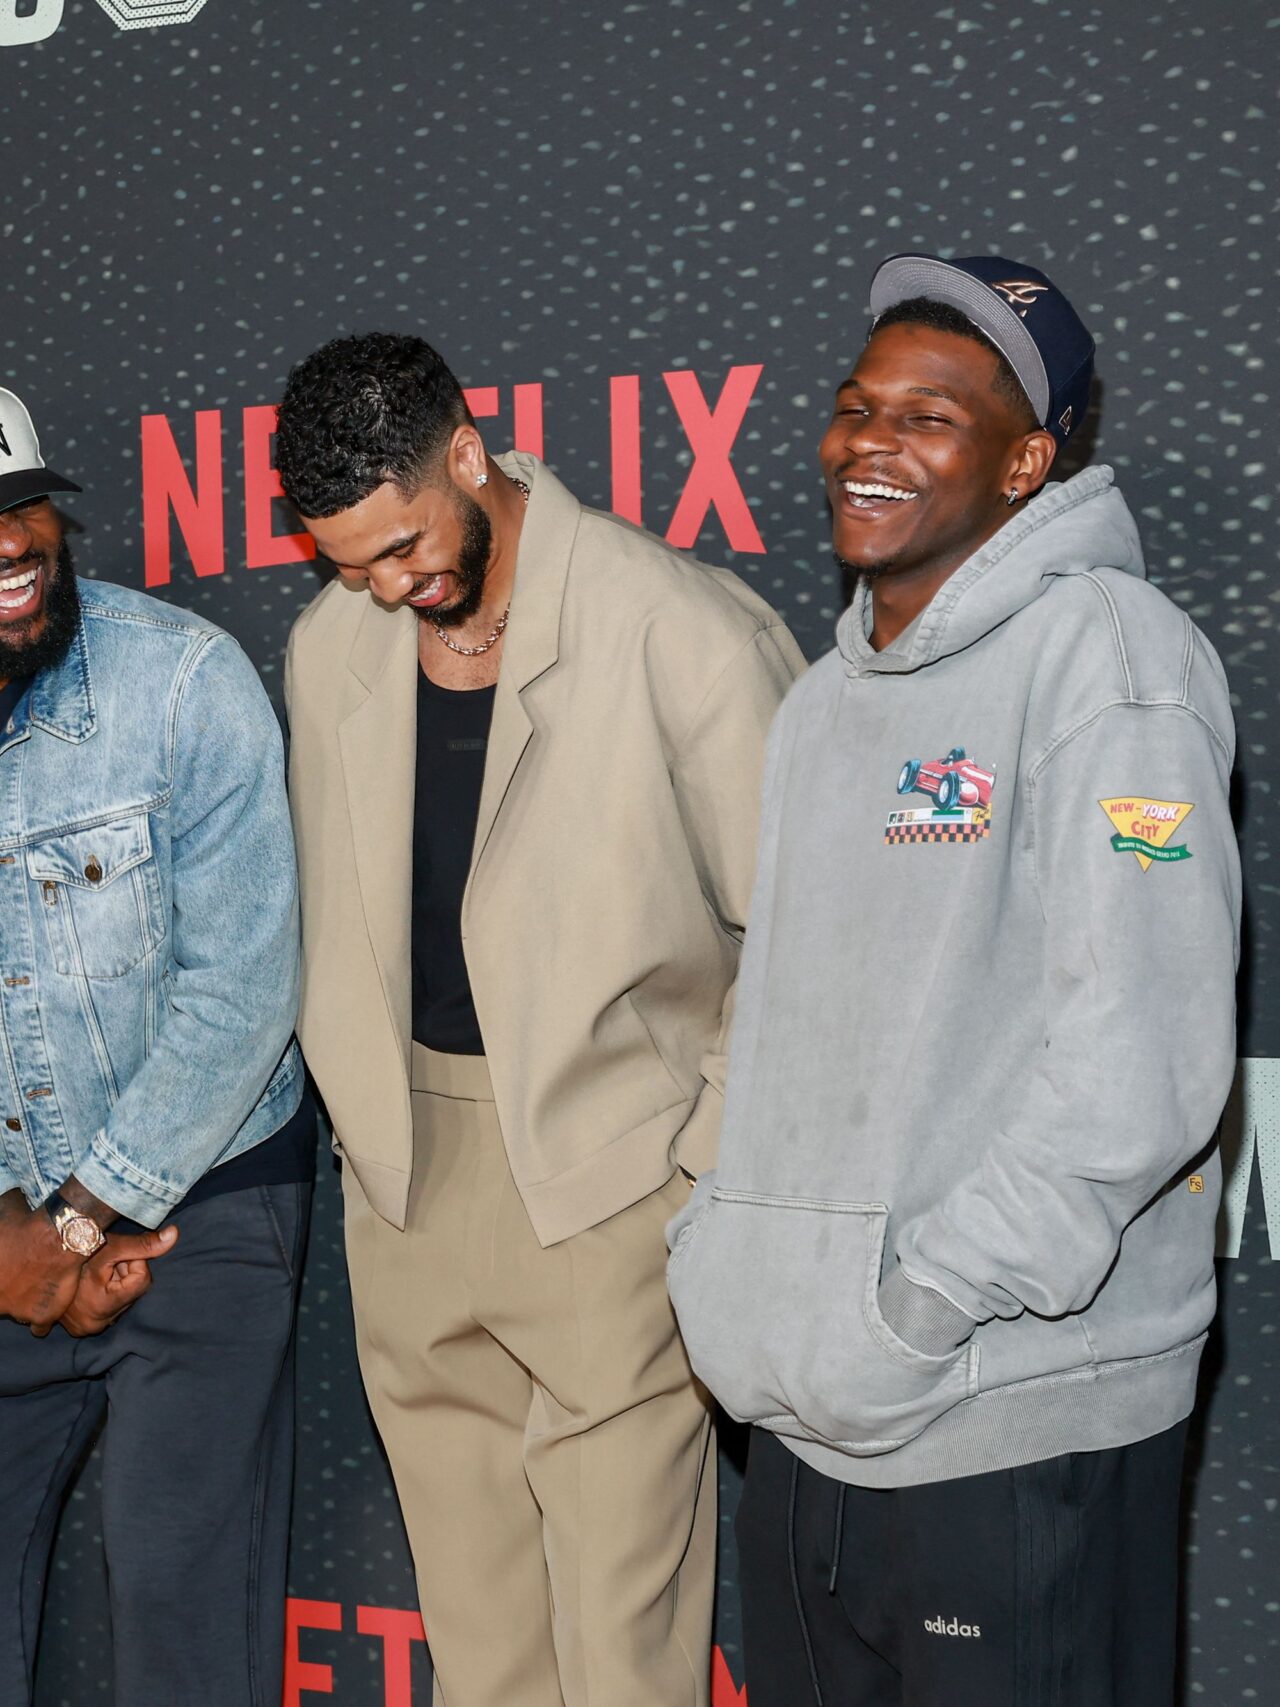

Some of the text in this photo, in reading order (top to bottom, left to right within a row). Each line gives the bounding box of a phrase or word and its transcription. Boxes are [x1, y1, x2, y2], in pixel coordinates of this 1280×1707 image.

[140, 364, 767, 588] NEIX
[1131, 821, 1160, 840] CITY
[924, 1615, 981, 1637] adidas
